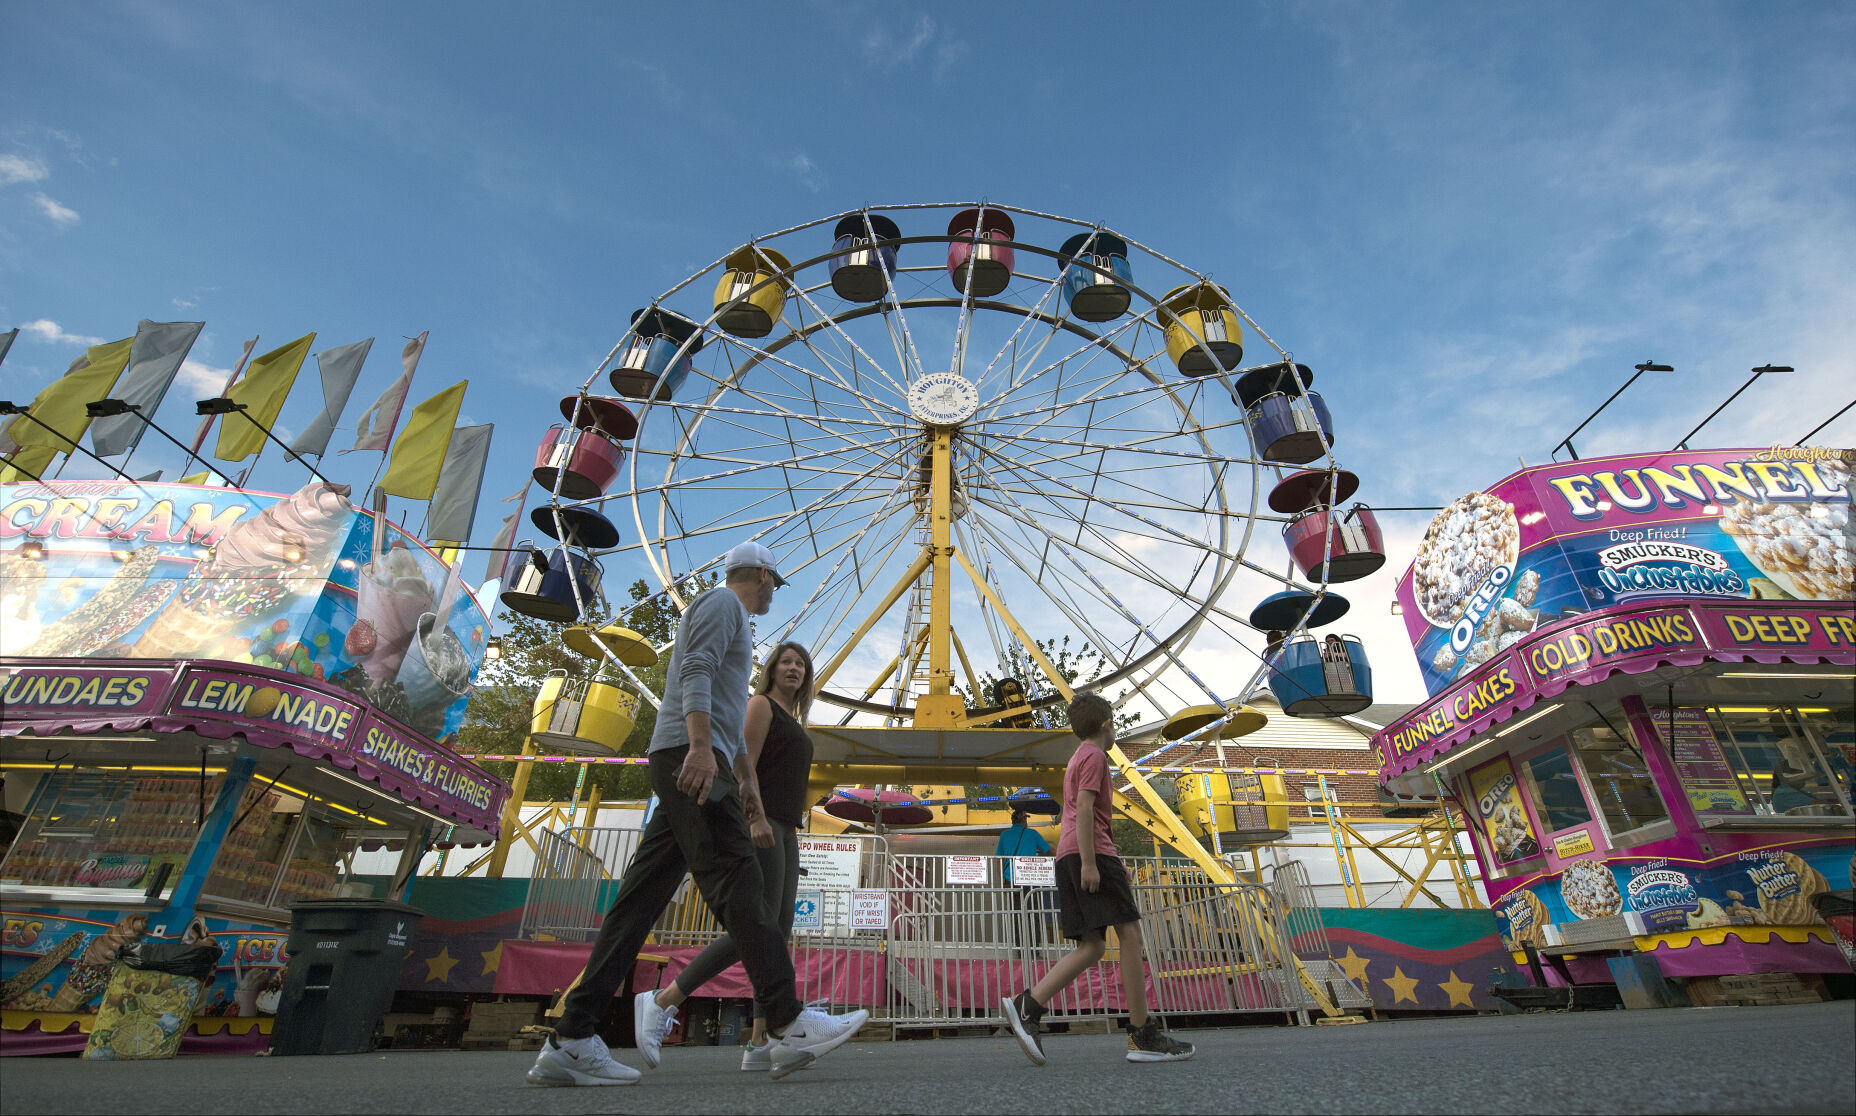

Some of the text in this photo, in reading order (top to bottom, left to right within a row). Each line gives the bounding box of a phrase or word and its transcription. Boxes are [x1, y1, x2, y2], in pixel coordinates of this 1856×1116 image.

[917, 378, 968, 394] HOUGHTON
[1549, 461, 1851, 519] FUNNEL
[0, 497, 248, 547] CREAM
[1610, 527, 1687, 544] Deep Fried!
[1607, 543, 1717, 566] SMUCKER'S
[1451, 566, 1511, 654] OREO
[1724, 615, 1811, 644] DEEP
[1531, 614, 1694, 676] COLD DRINKS
[3, 676, 150, 705] UNDAES
[1393, 706, 1454, 757] FUNNEL
[1454, 667, 1516, 721] CAKES
[1653, 710, 1700, 720] Hoghton's
[362, 727, 424, 780] SHAKES
[424, 760, 435, 784] &
[434, 762, 493, 812] FLURRIES
[1480, 774, 1515, 817] OREO
[798, 842, 857, 852] XPO WHEEL RULES
[1739, 849, 1784, 862] Deep Fried!
[1648, 856, 1668, 870] Fried!
[1746, 861, 1788, 885] Nutter
[1631, 872, 1683, 892] SMUCKER'S
[1760, 872, 1798, 898] Butter
[798, 902, 809, 913] 4
[1504, 899, 1527, 920] Nutter
[1510, 907, 1533, 930] Butter
[231, 938, 278, 962] ICE
